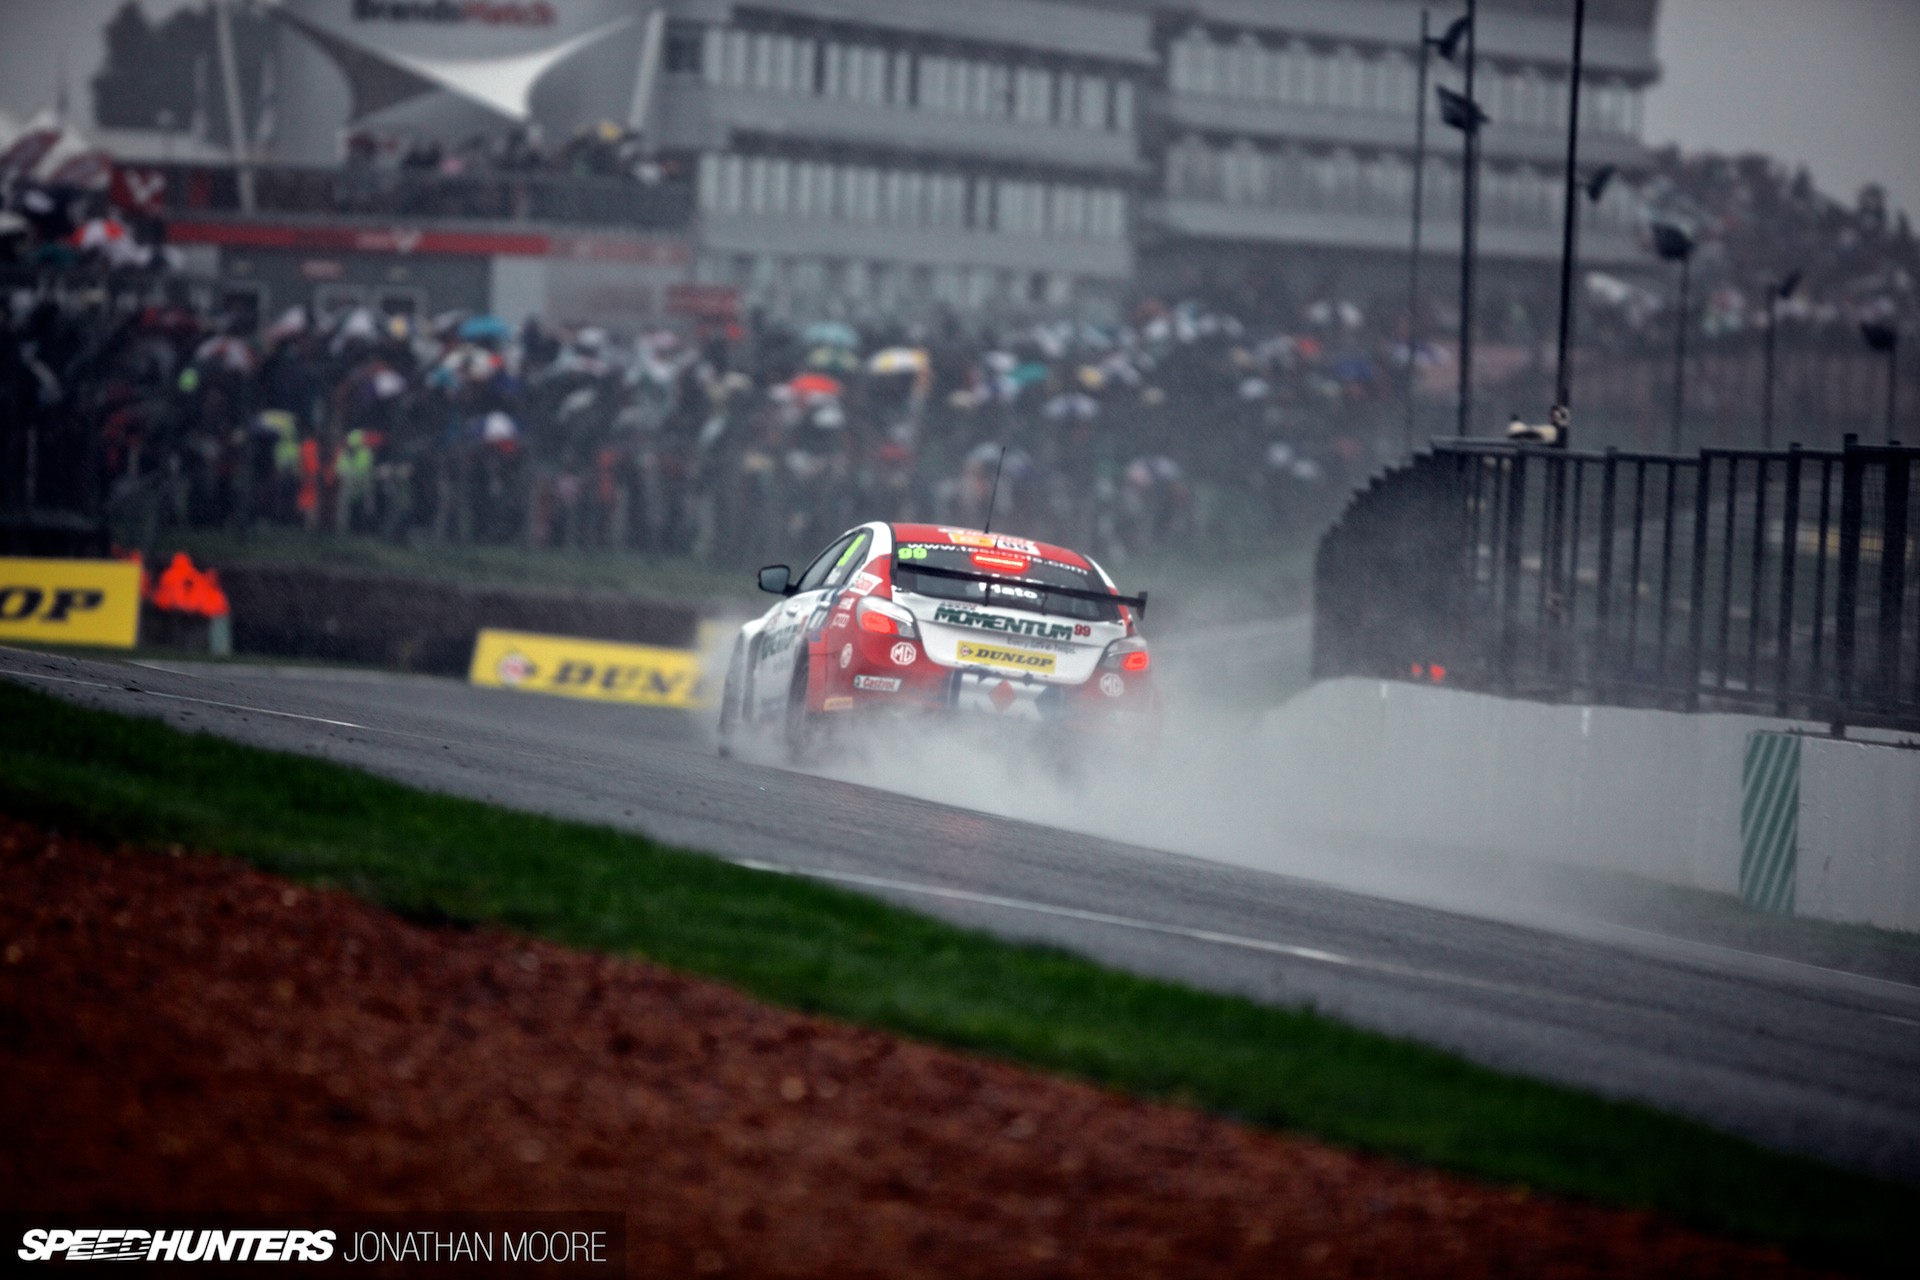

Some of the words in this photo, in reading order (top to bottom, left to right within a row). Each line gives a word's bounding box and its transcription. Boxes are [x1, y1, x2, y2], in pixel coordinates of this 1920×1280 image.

[897, 547, 927, 560] 99
[934, 606, 1073, 640] MOMENTUM
[1073, 623, 1091, 637] 99
[893, 644, 914, 663] MG
[976, 648, 1053, 667] DUNLOP
[555, 660, 708, 699] DUN
[863, 677, 896, 690] Castrol
